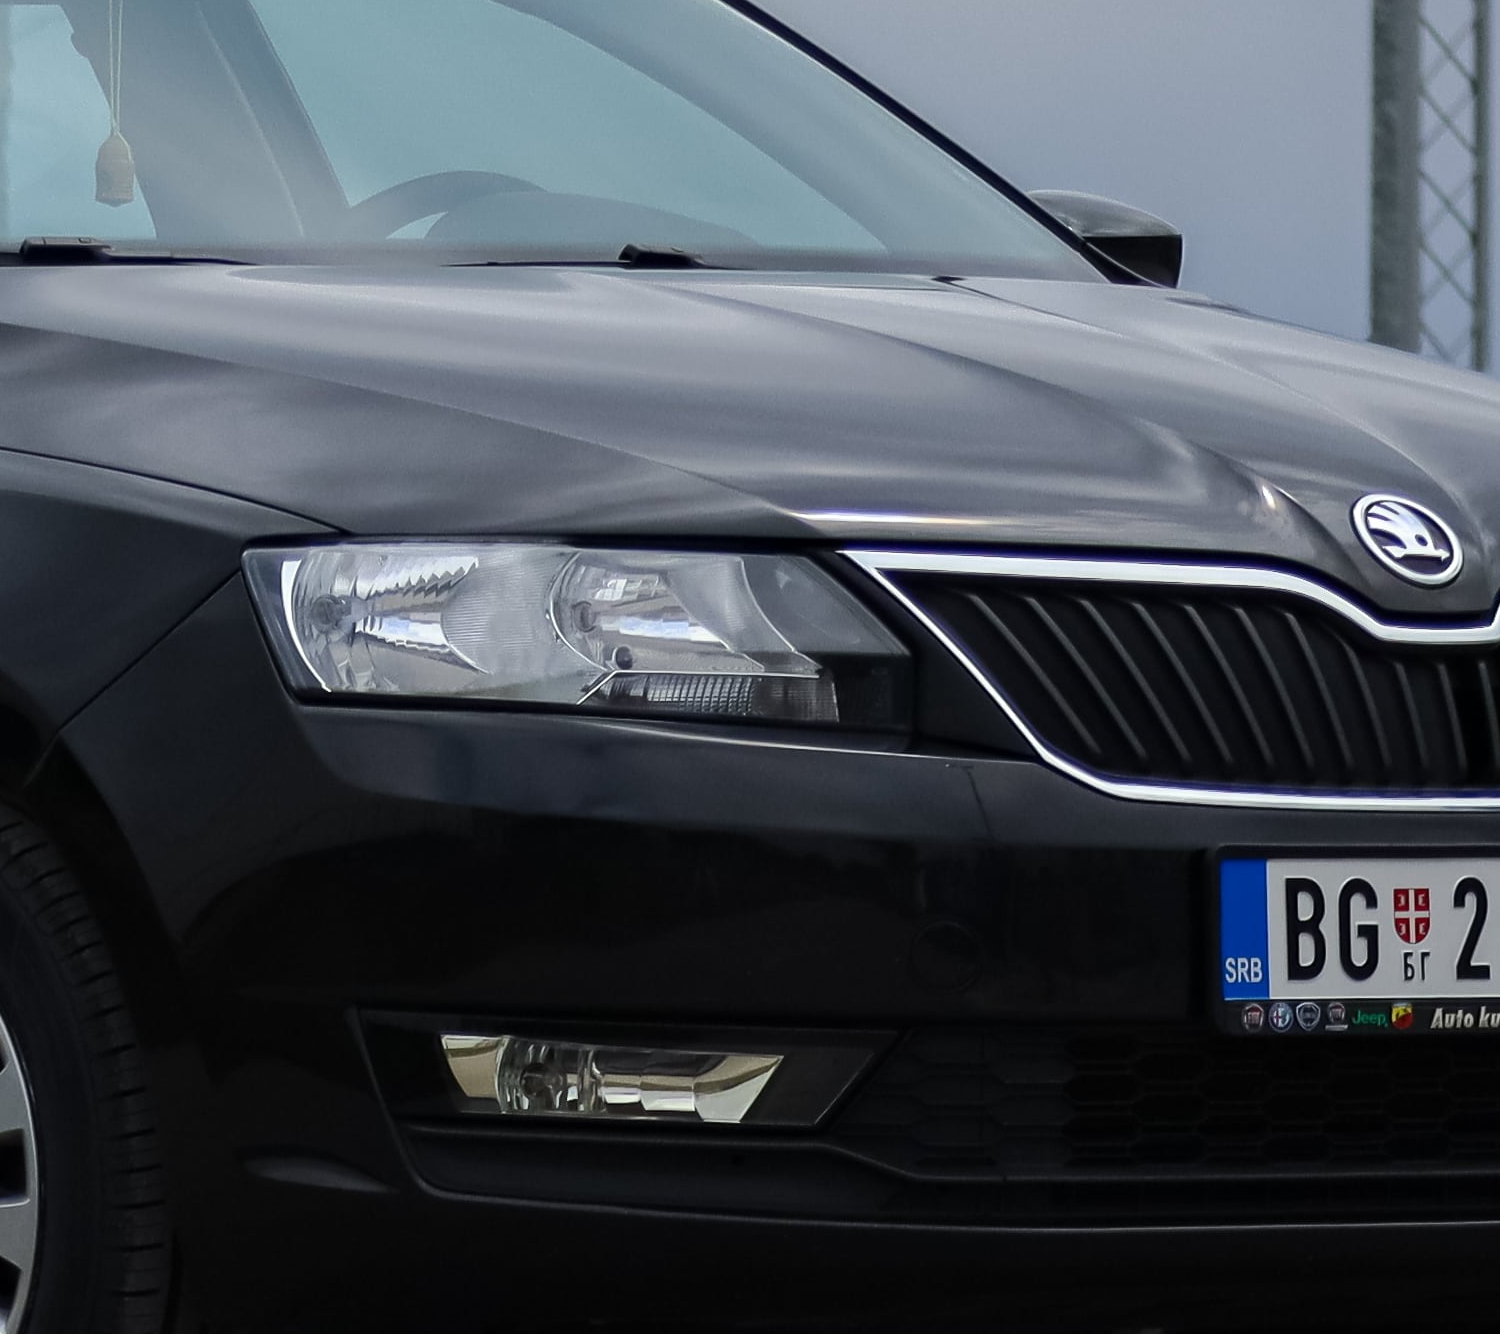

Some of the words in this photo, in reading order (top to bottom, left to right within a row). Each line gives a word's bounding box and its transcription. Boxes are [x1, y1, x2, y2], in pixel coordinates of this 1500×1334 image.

[1284, 877, 1379, 982] BG
[1225, 957, 1263, 983] SRB
[1352, 1009, 1387, 1028] Jeep
[1431, 1007, 1475, 1029] Auto
